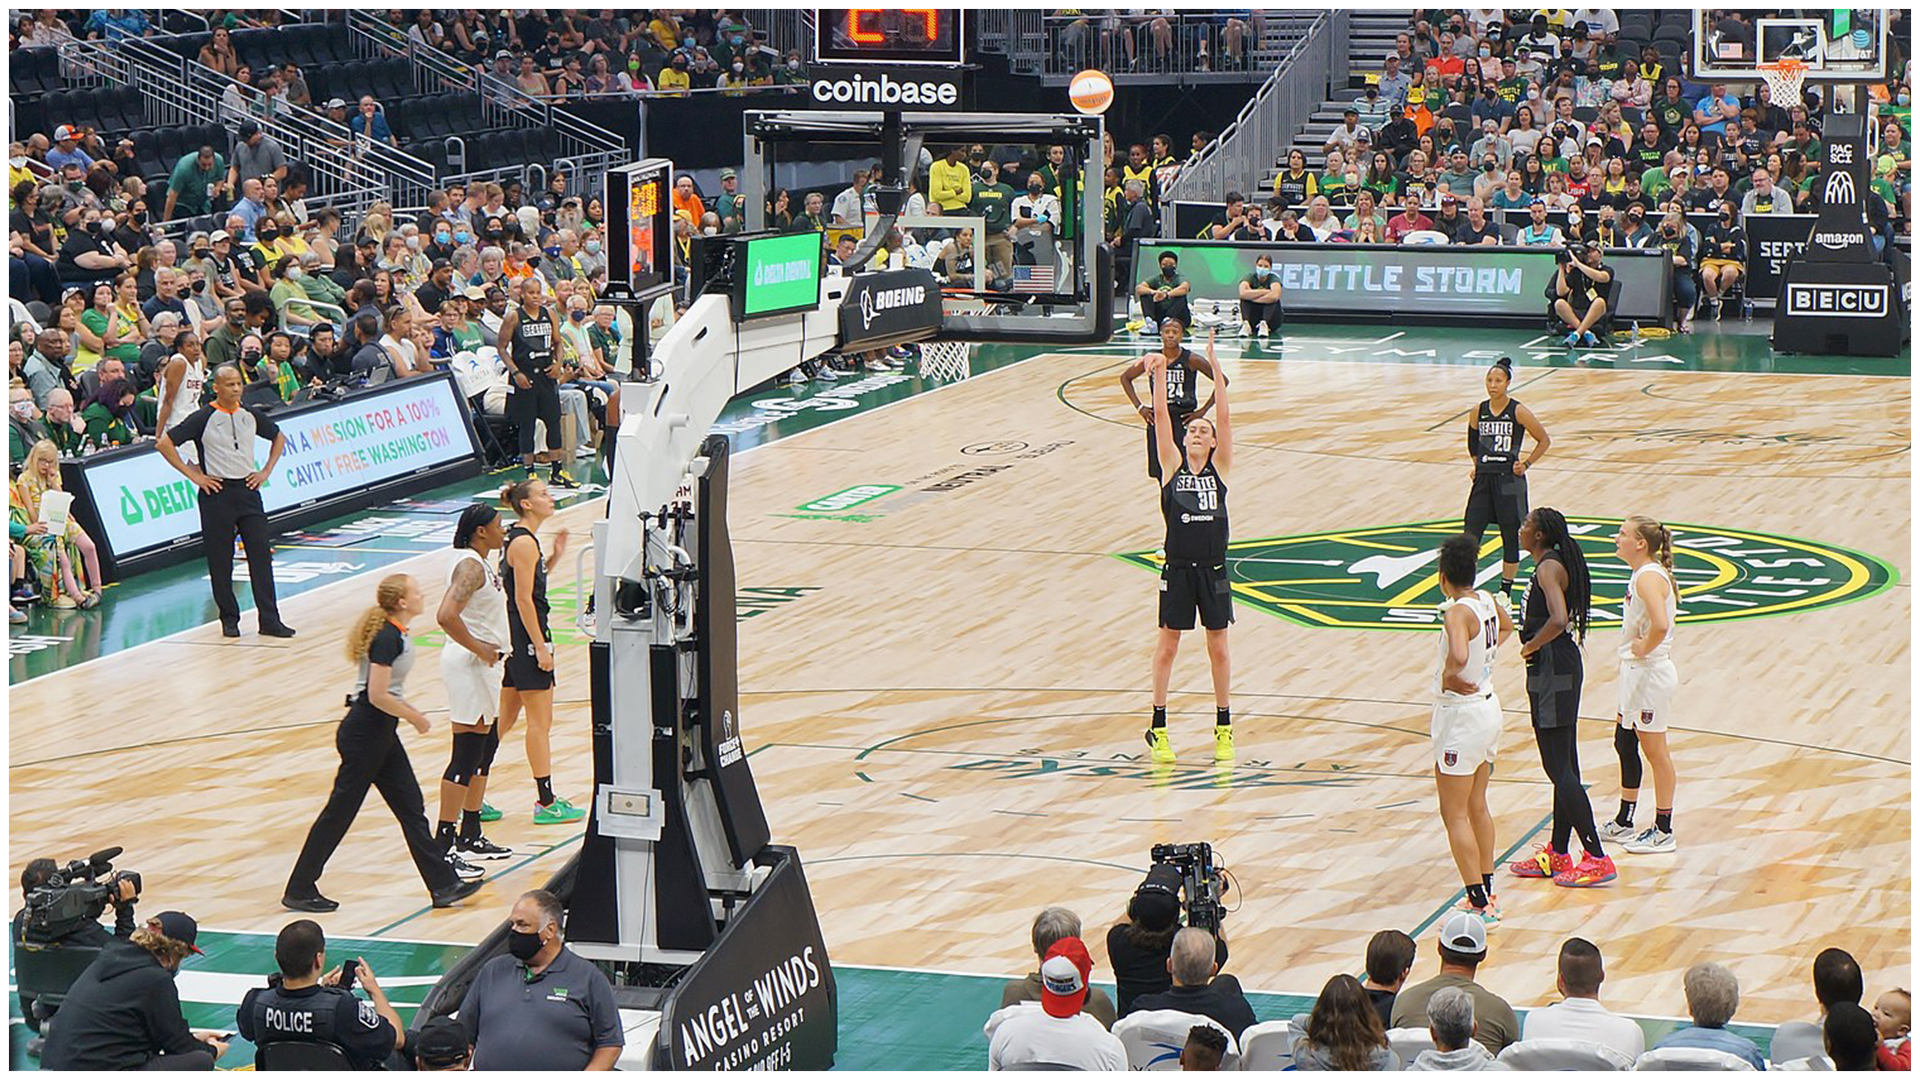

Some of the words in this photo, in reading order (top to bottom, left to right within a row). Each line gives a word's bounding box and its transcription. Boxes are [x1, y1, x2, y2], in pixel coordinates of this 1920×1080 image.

[813, 73, 957, 105] coinbase
[1830, 144, 1852, 154] PAC
[1830, 154, 1852, 164] SCI
[1815, 233, 1863, 246] amazon
[1272, 263, 1402, 291] EATTLE
[1415, 265, 1522, 295] STORM
[876, 286, 925, 310] BOEING
[1261, 345, 1685, 364] SYMETRA
[1168, 383, 1184, 398] 24
[300, 431, 312, 452] A
[311, 416, 367, 447] MISSION
[365, 409, 395, 433] FOR
[396, 406, 407, 426] A
[406, 396, 441, 423] 100%
[1478, 421, 1513, 435] SEATTLE
[1494, 435, 1512, 452] 20
[286, 457, 334, 488] CAVITY
[335, 449, 370, 476] FREE
[367, 426, 451, 466] WASHINGTON
[1177, 476, 1217, 491] SEATLE
[1198, 491, 1218, 510] 30
[1484, 616, 1497, 649] 00
[720, 748, 742, 768] CHANGE
[754, 946, 819, 1018] WINDS
[744, 989, 754, 1004] OF
[265, 1007, 313, 1033] POLICE
[746, 1003, 760, 1019] THE
[681, 993, 749, 1067] ANGEL
[715, 1039, 759, 1071] CASINO
[762, 1008, 804, 1047] RESORT
[780, 1041, 791, 1066] I-5
